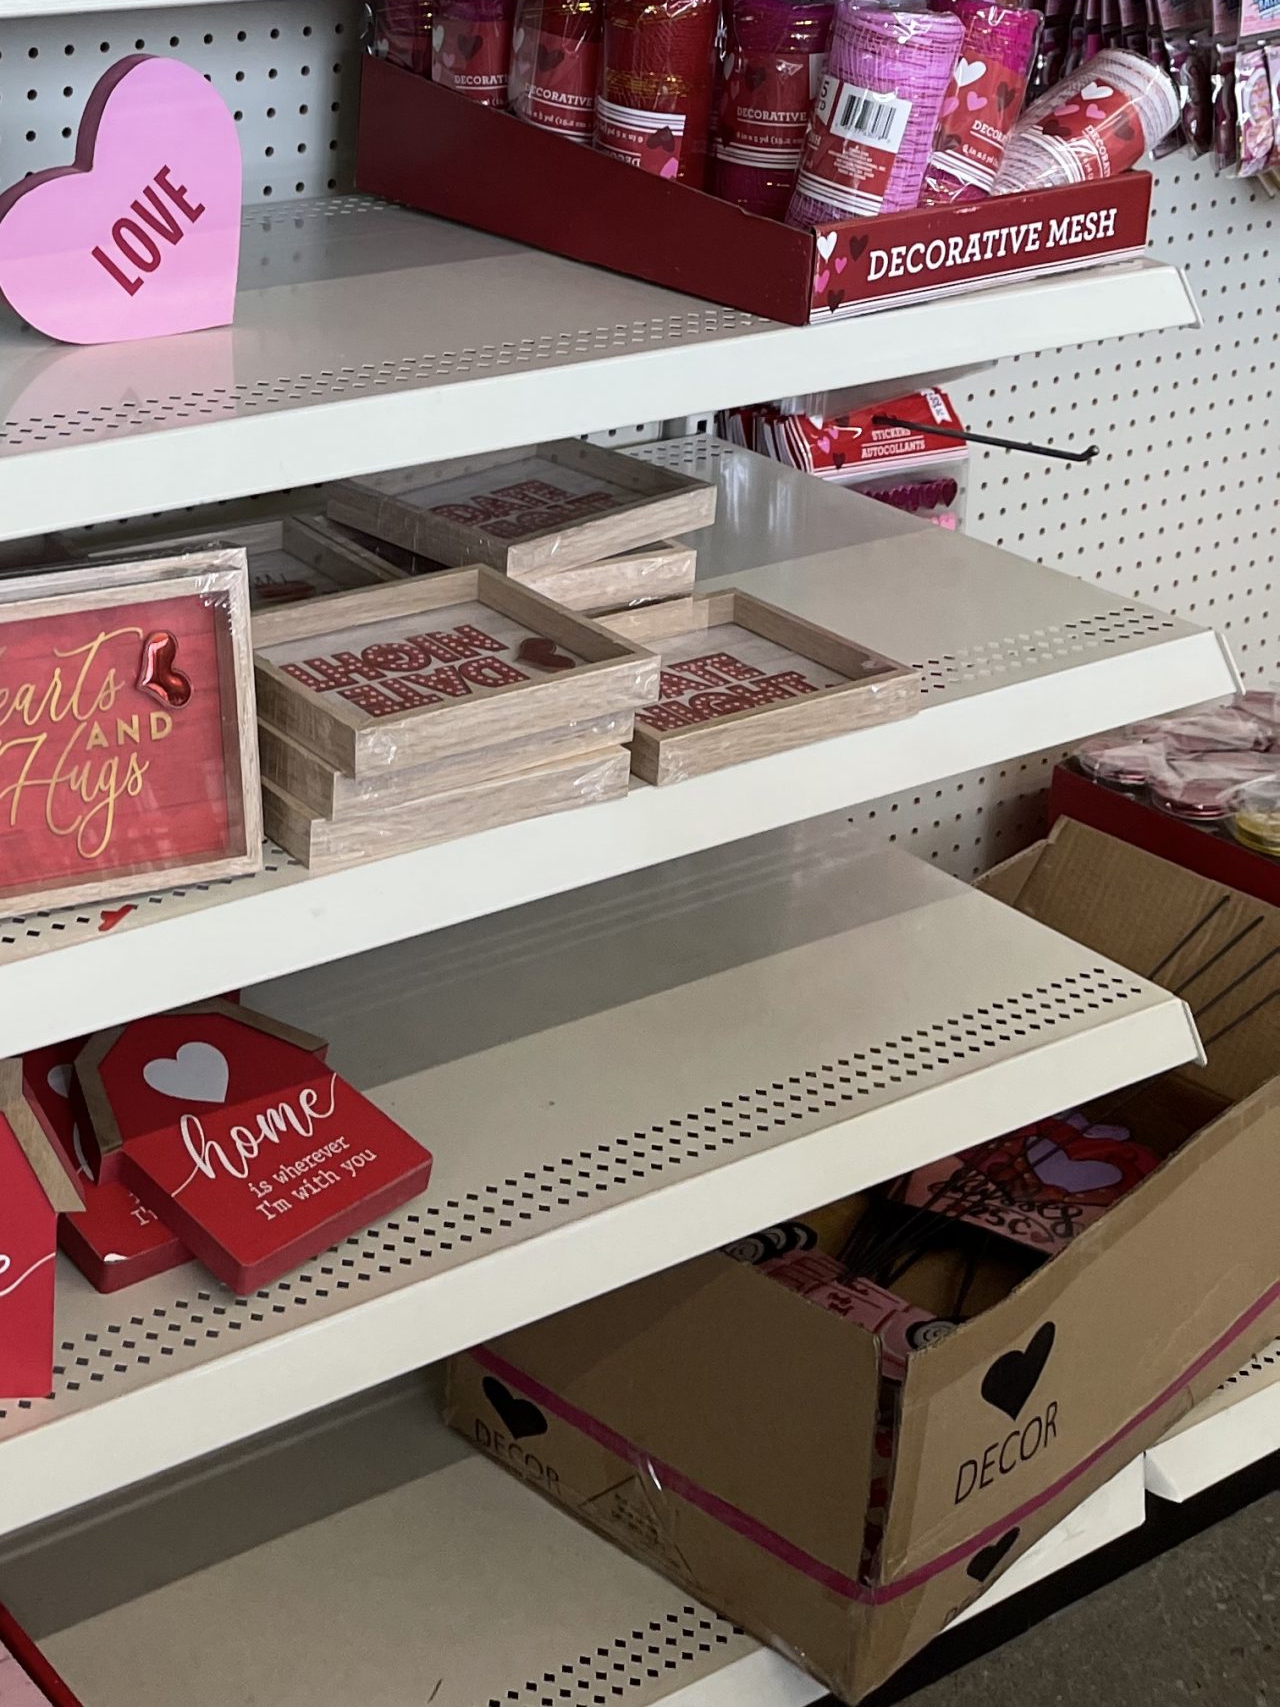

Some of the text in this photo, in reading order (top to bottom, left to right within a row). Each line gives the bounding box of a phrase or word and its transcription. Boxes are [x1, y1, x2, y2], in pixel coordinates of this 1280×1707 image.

[737, 106, 807, 122] DECORATIVE
[90, 164, 206, 297] LOVE
[867, 208, 1117, 282] DECORATIVE MESH
[861, 440, 926, 459] AUTOCOLLANTS
[659, 652, 767, 701] ATE
[86, 711, 174, 751] AND
[172, 1072, 338, 1197] home
[248, 1133, 351, 1201] is wherever
[255, 1147, 377, 1222] I'm with you
[954, 1400, 1059, 1505] DECOR
